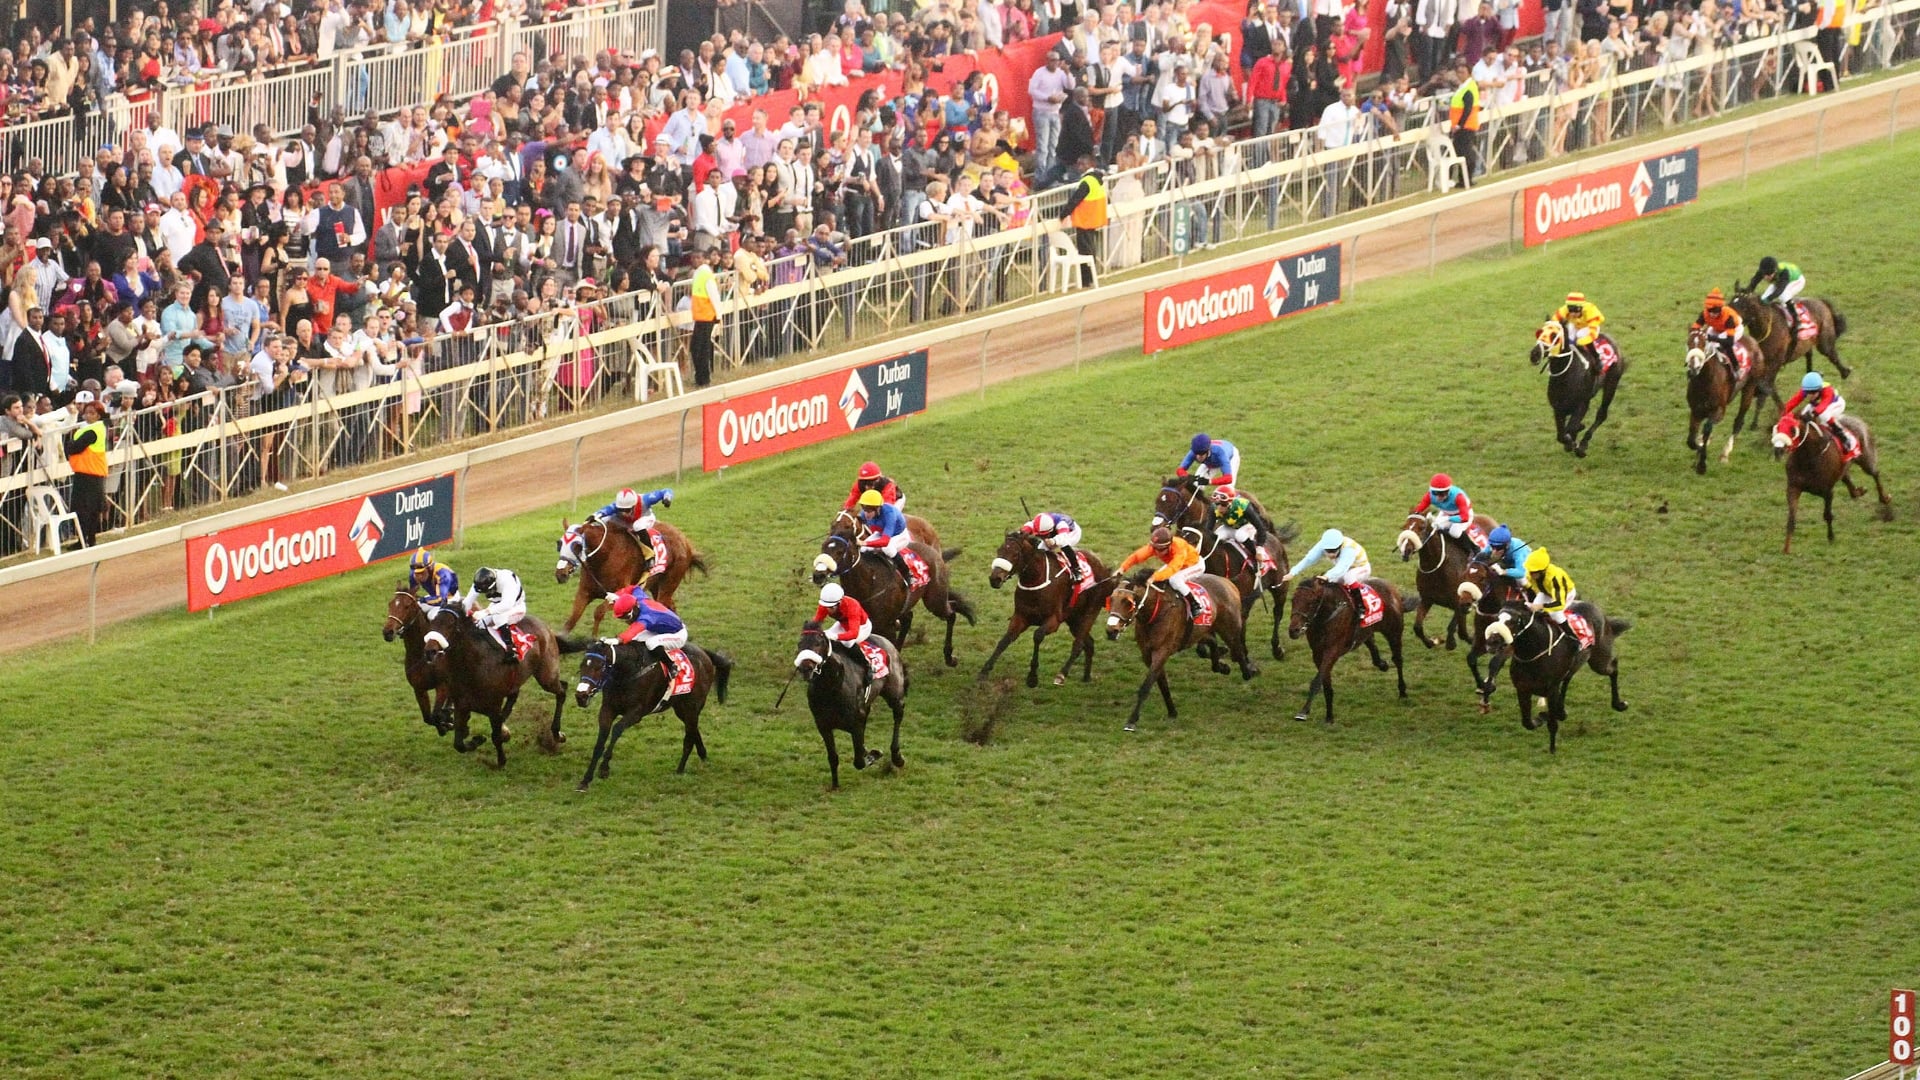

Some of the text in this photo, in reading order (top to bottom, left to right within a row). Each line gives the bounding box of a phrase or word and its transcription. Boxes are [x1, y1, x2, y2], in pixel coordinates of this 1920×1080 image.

[1658, 156, 1686, 179] Durban
[1551, 182, 1622, 224] vodacom
[1665, 179, 1680, 205] July
[1174, 207, 1186, 252] 150
[1297, 255, 1326, 279] Durban
[1175, 283, 1255, 330] vodacom
[1304, 280, 1320, 307] July
[878, 361, 911, 386] Durban
[886, 388, 903, 417] July
[738, 394, 829, 445] vodacom
[395, 487, 433, 516] Durban
[404, 517, 425, 548] July
[229, 525, 337, 581] vodacom
[1893, 993, 1910, 1060] 100
